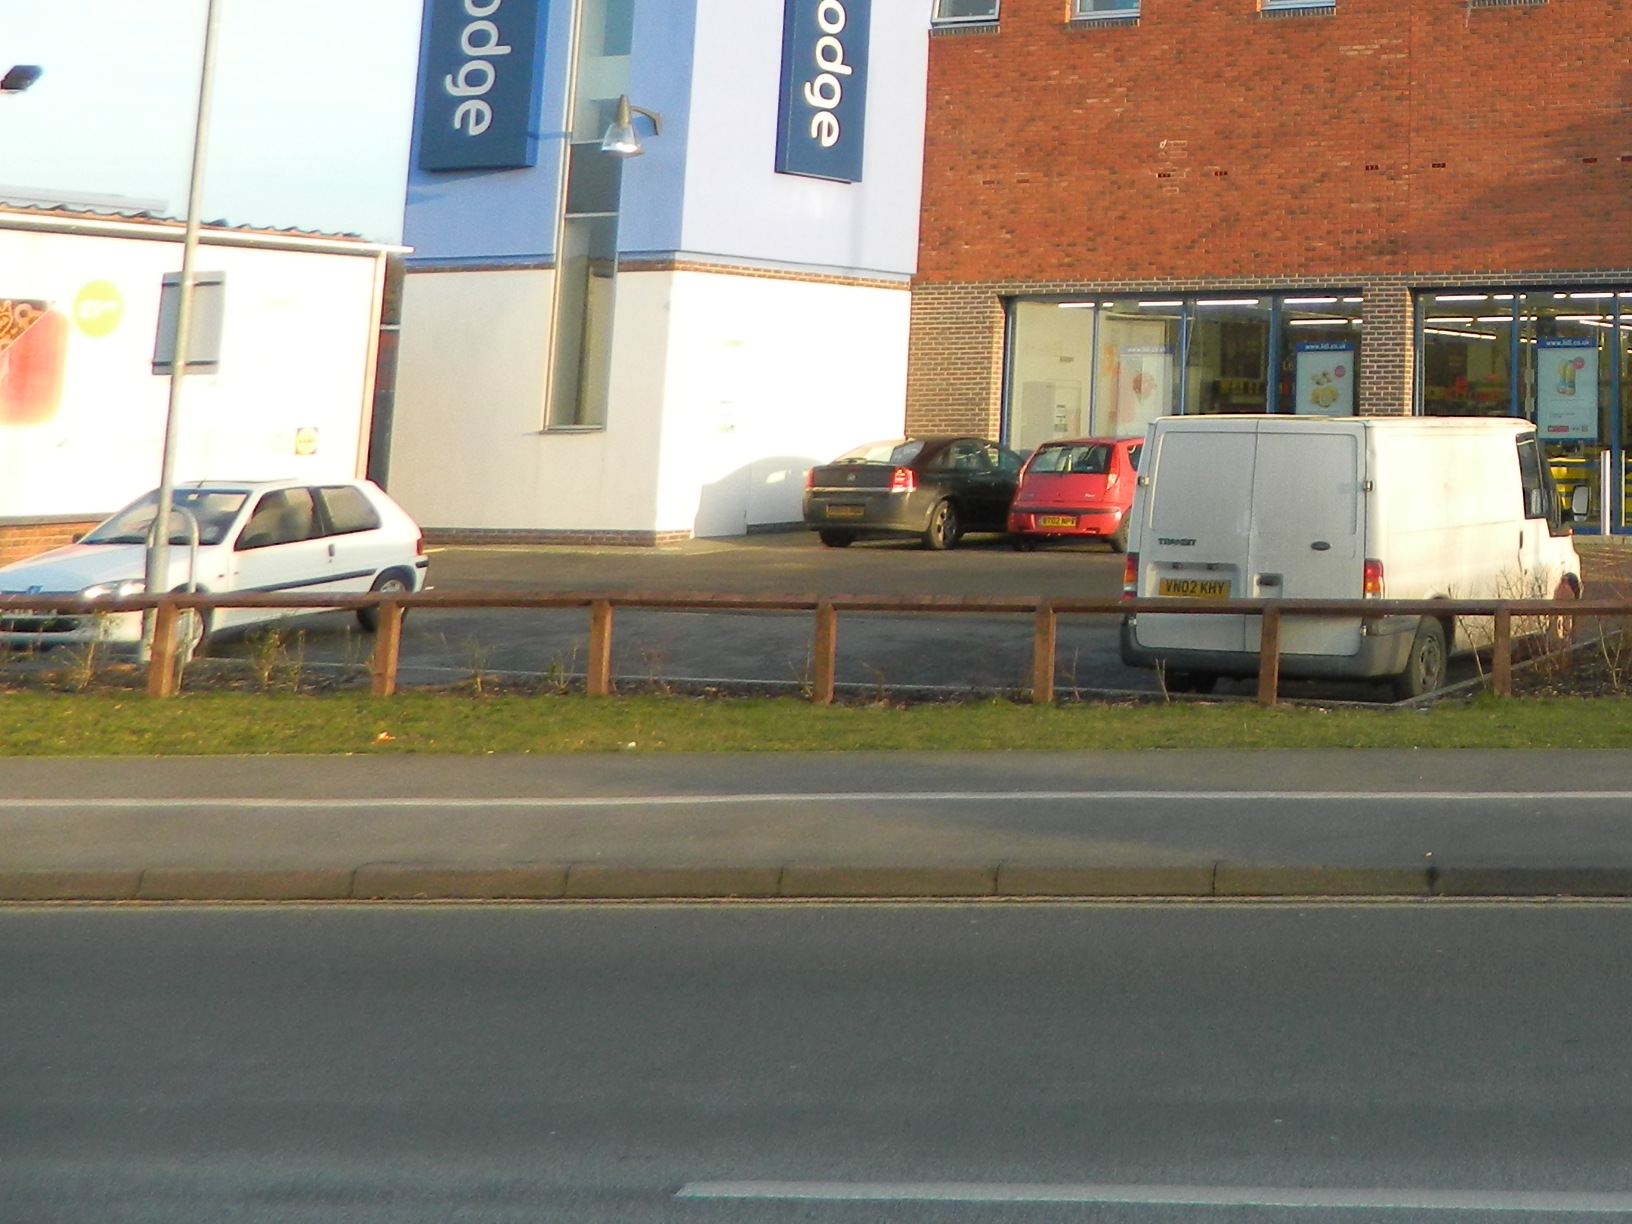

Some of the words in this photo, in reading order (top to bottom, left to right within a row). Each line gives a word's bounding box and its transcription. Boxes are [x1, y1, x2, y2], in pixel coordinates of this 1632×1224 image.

[1546, 338, 1590, 346] www.lidl.co.uk
[1158, 537, 1197, 547] TRANSIT
[1166, 579, 1198, 594] VN02
[1200, 580, 1225, 595] KHY
